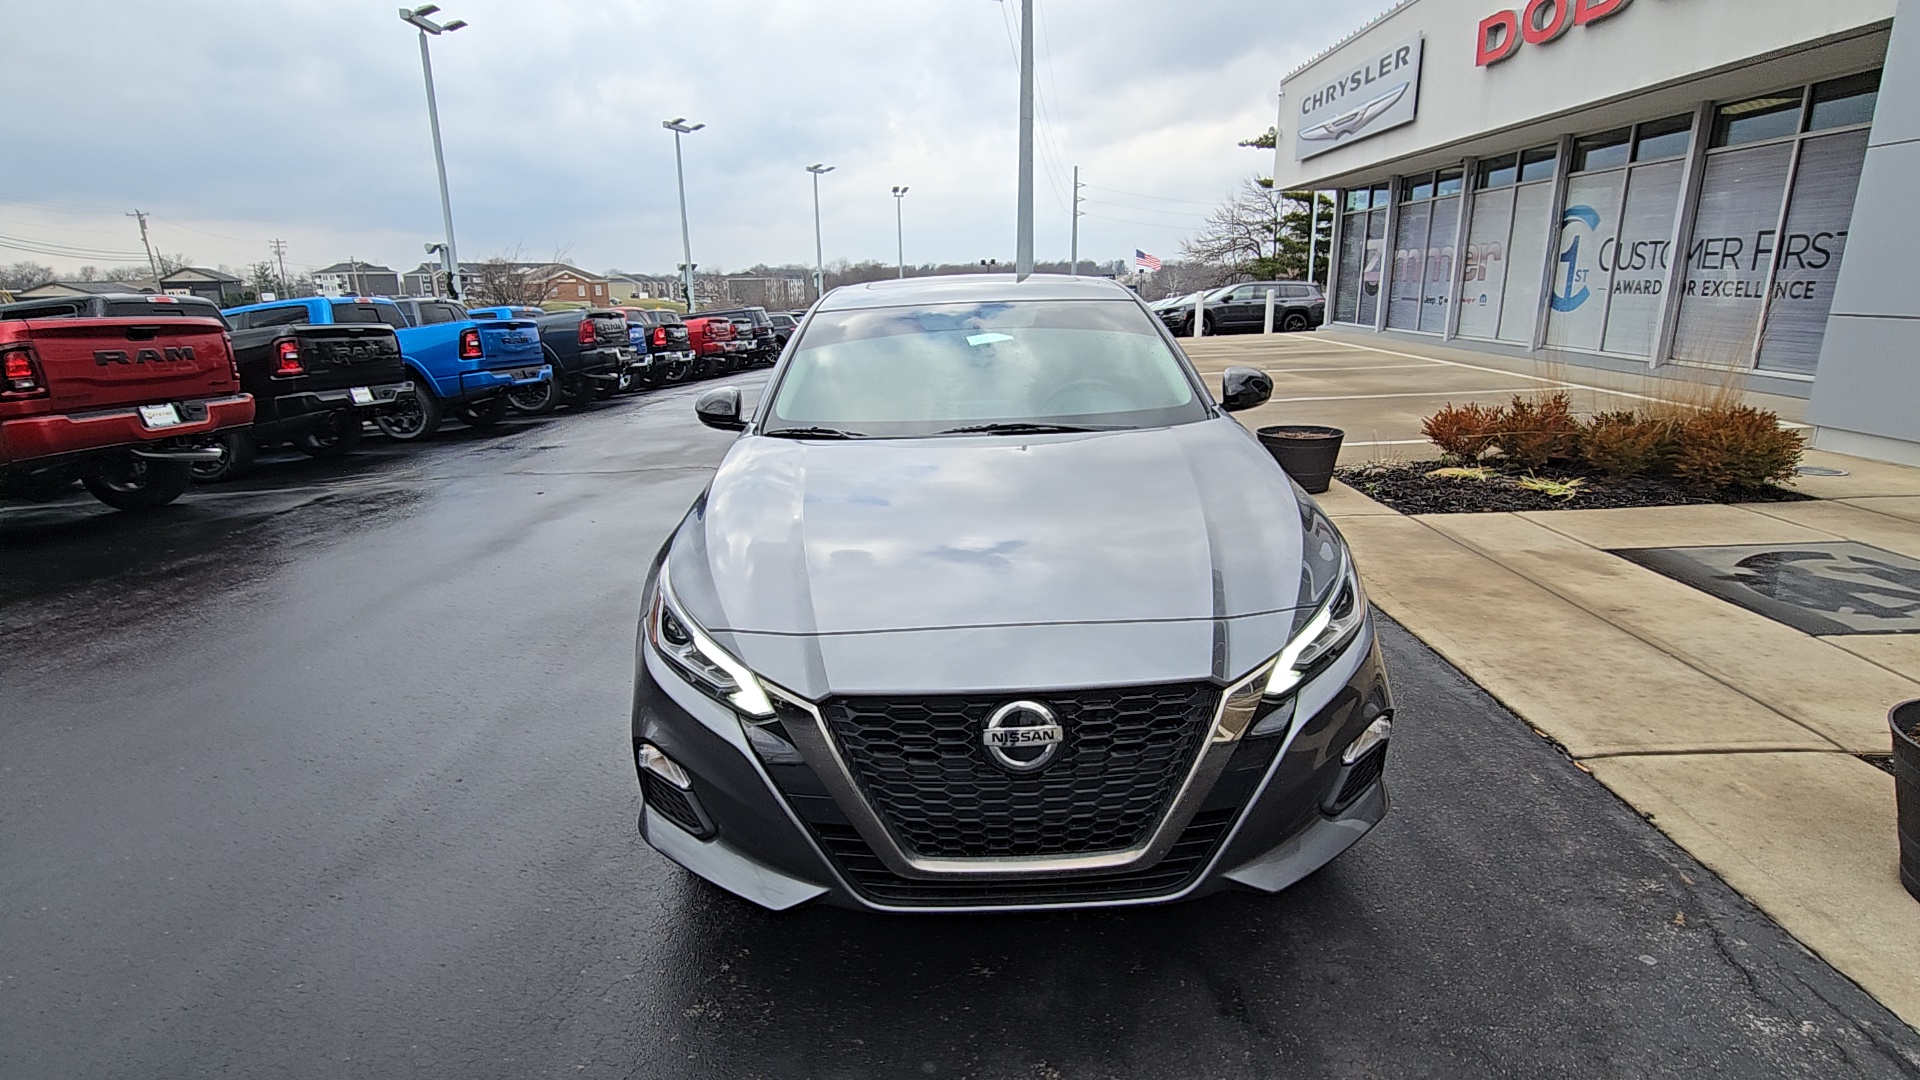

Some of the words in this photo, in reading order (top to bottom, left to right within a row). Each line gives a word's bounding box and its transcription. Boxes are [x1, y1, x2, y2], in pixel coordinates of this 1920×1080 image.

[1301, 45, 1411, 115] CHRYSLER
[1613, 279, 1662, 295] AWARD
[1701, 279, 1817, 300] EXCELLNCE
[92, 345, 196, 366] RAM
[991, 729, 1055, 743] NISSAN
